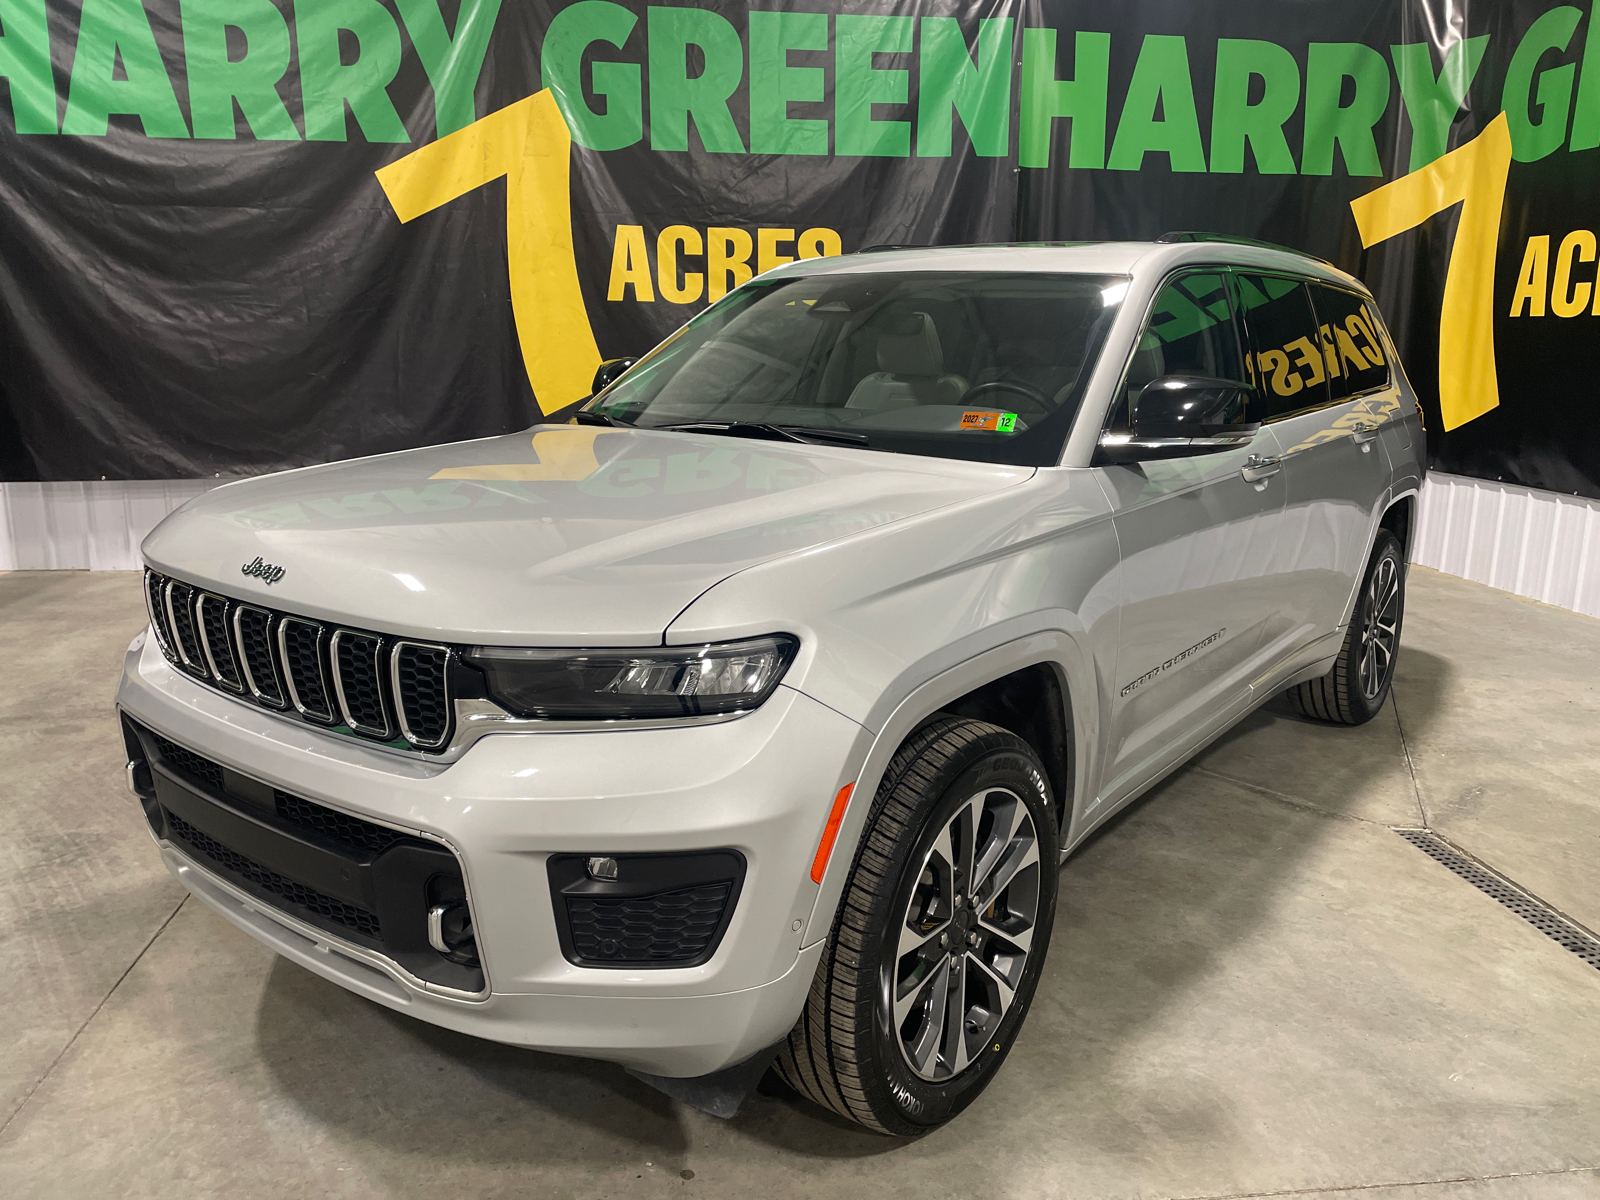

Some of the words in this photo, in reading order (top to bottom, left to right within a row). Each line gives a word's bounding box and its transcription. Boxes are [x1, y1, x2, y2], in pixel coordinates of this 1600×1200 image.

[541, 0, 1014, 158] GREEN
[1019, 27, 1491, 178] HARRY
[374, 87, 603, 417] 7
[1350, 110, 1513, 433] 7
[1509, 229, 1600, 318] AC
[963, 414, 979, 423] 2027
[1001, 417, 1011, 427] 12
[241, 556, 287, 585] Jeep
